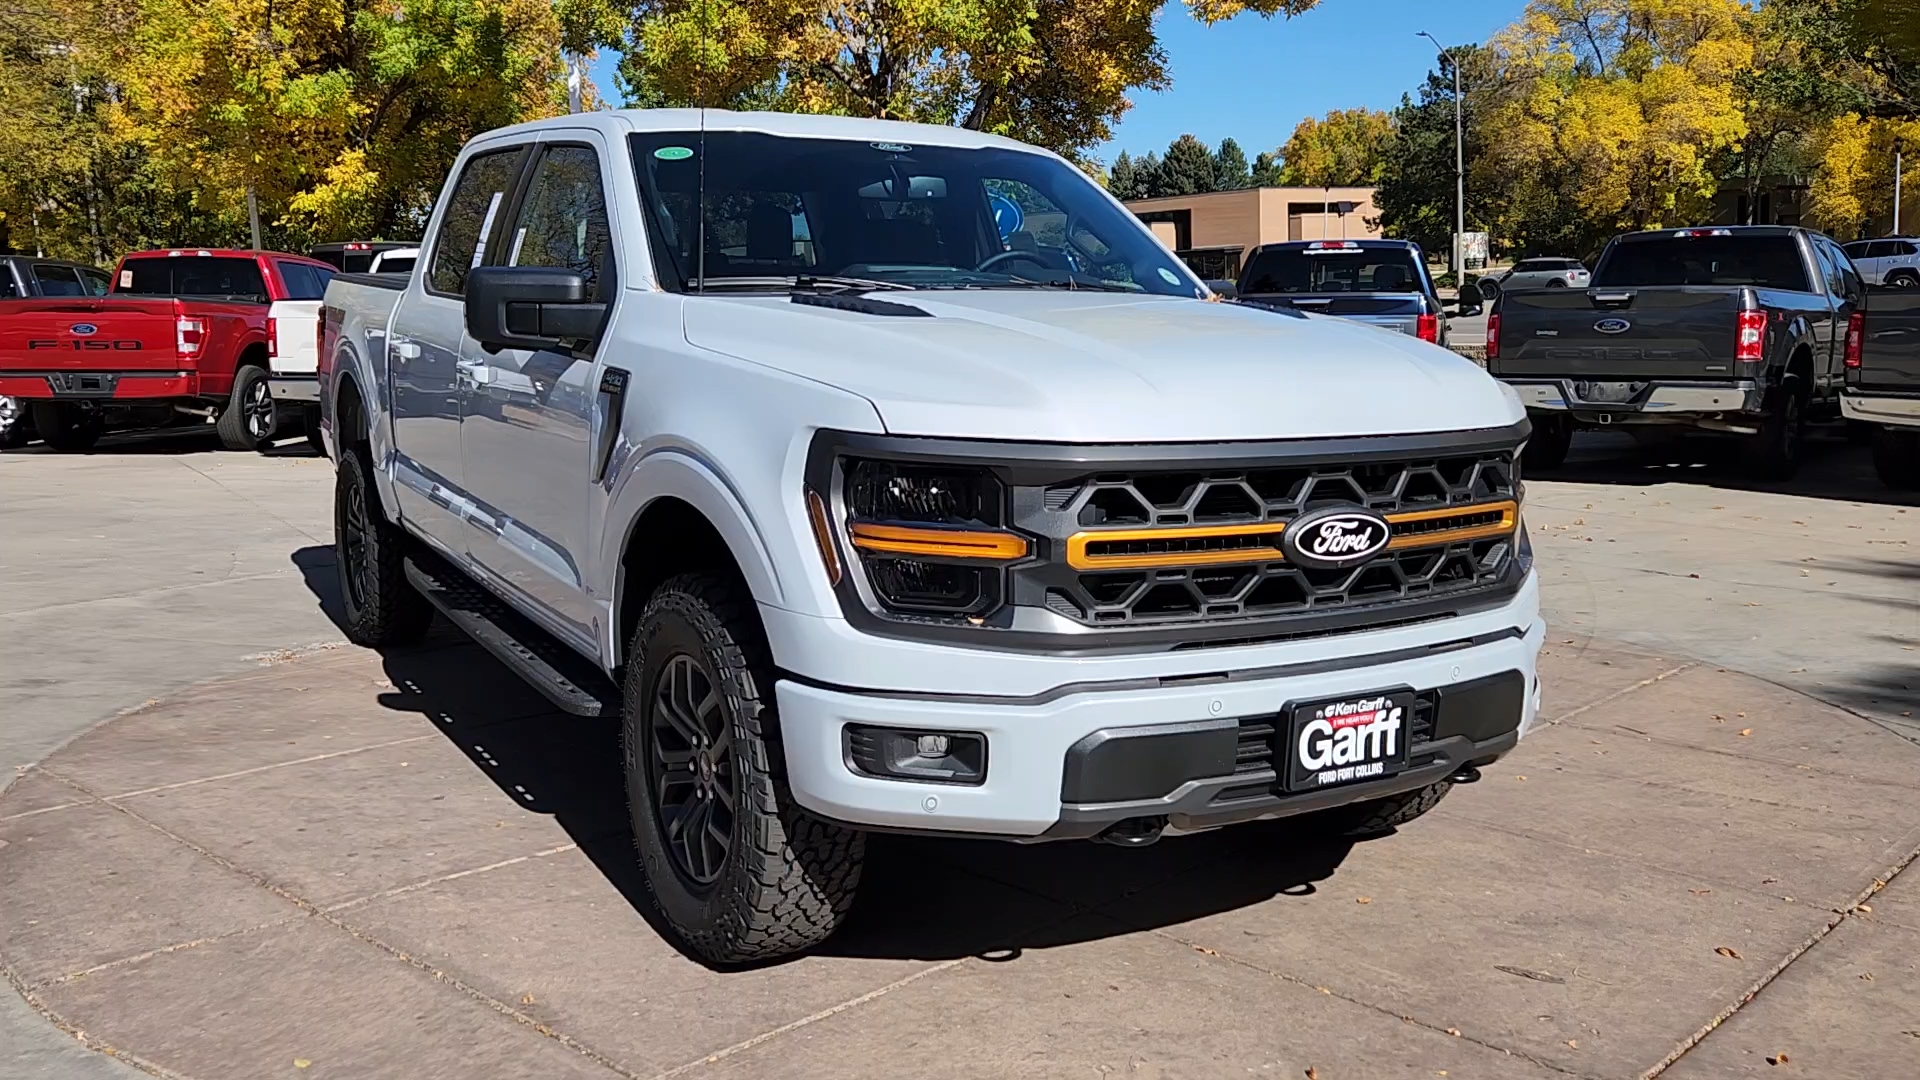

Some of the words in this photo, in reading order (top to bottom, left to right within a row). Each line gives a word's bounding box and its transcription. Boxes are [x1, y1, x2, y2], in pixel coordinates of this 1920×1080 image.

[28, 340, 142, 351] F-150
[1313, 521, 1372, 553] Ford
[1334, 702, 1357, 716] Ken
[1357, 697, 1385, 713] Garff
[1299, 707, 1402, 771] Garff
[1318, 770, 1337, 785] FORD
[1337, 766, 1355, 781] FORT
[1355, 762, 1384, 778] COLLINS
